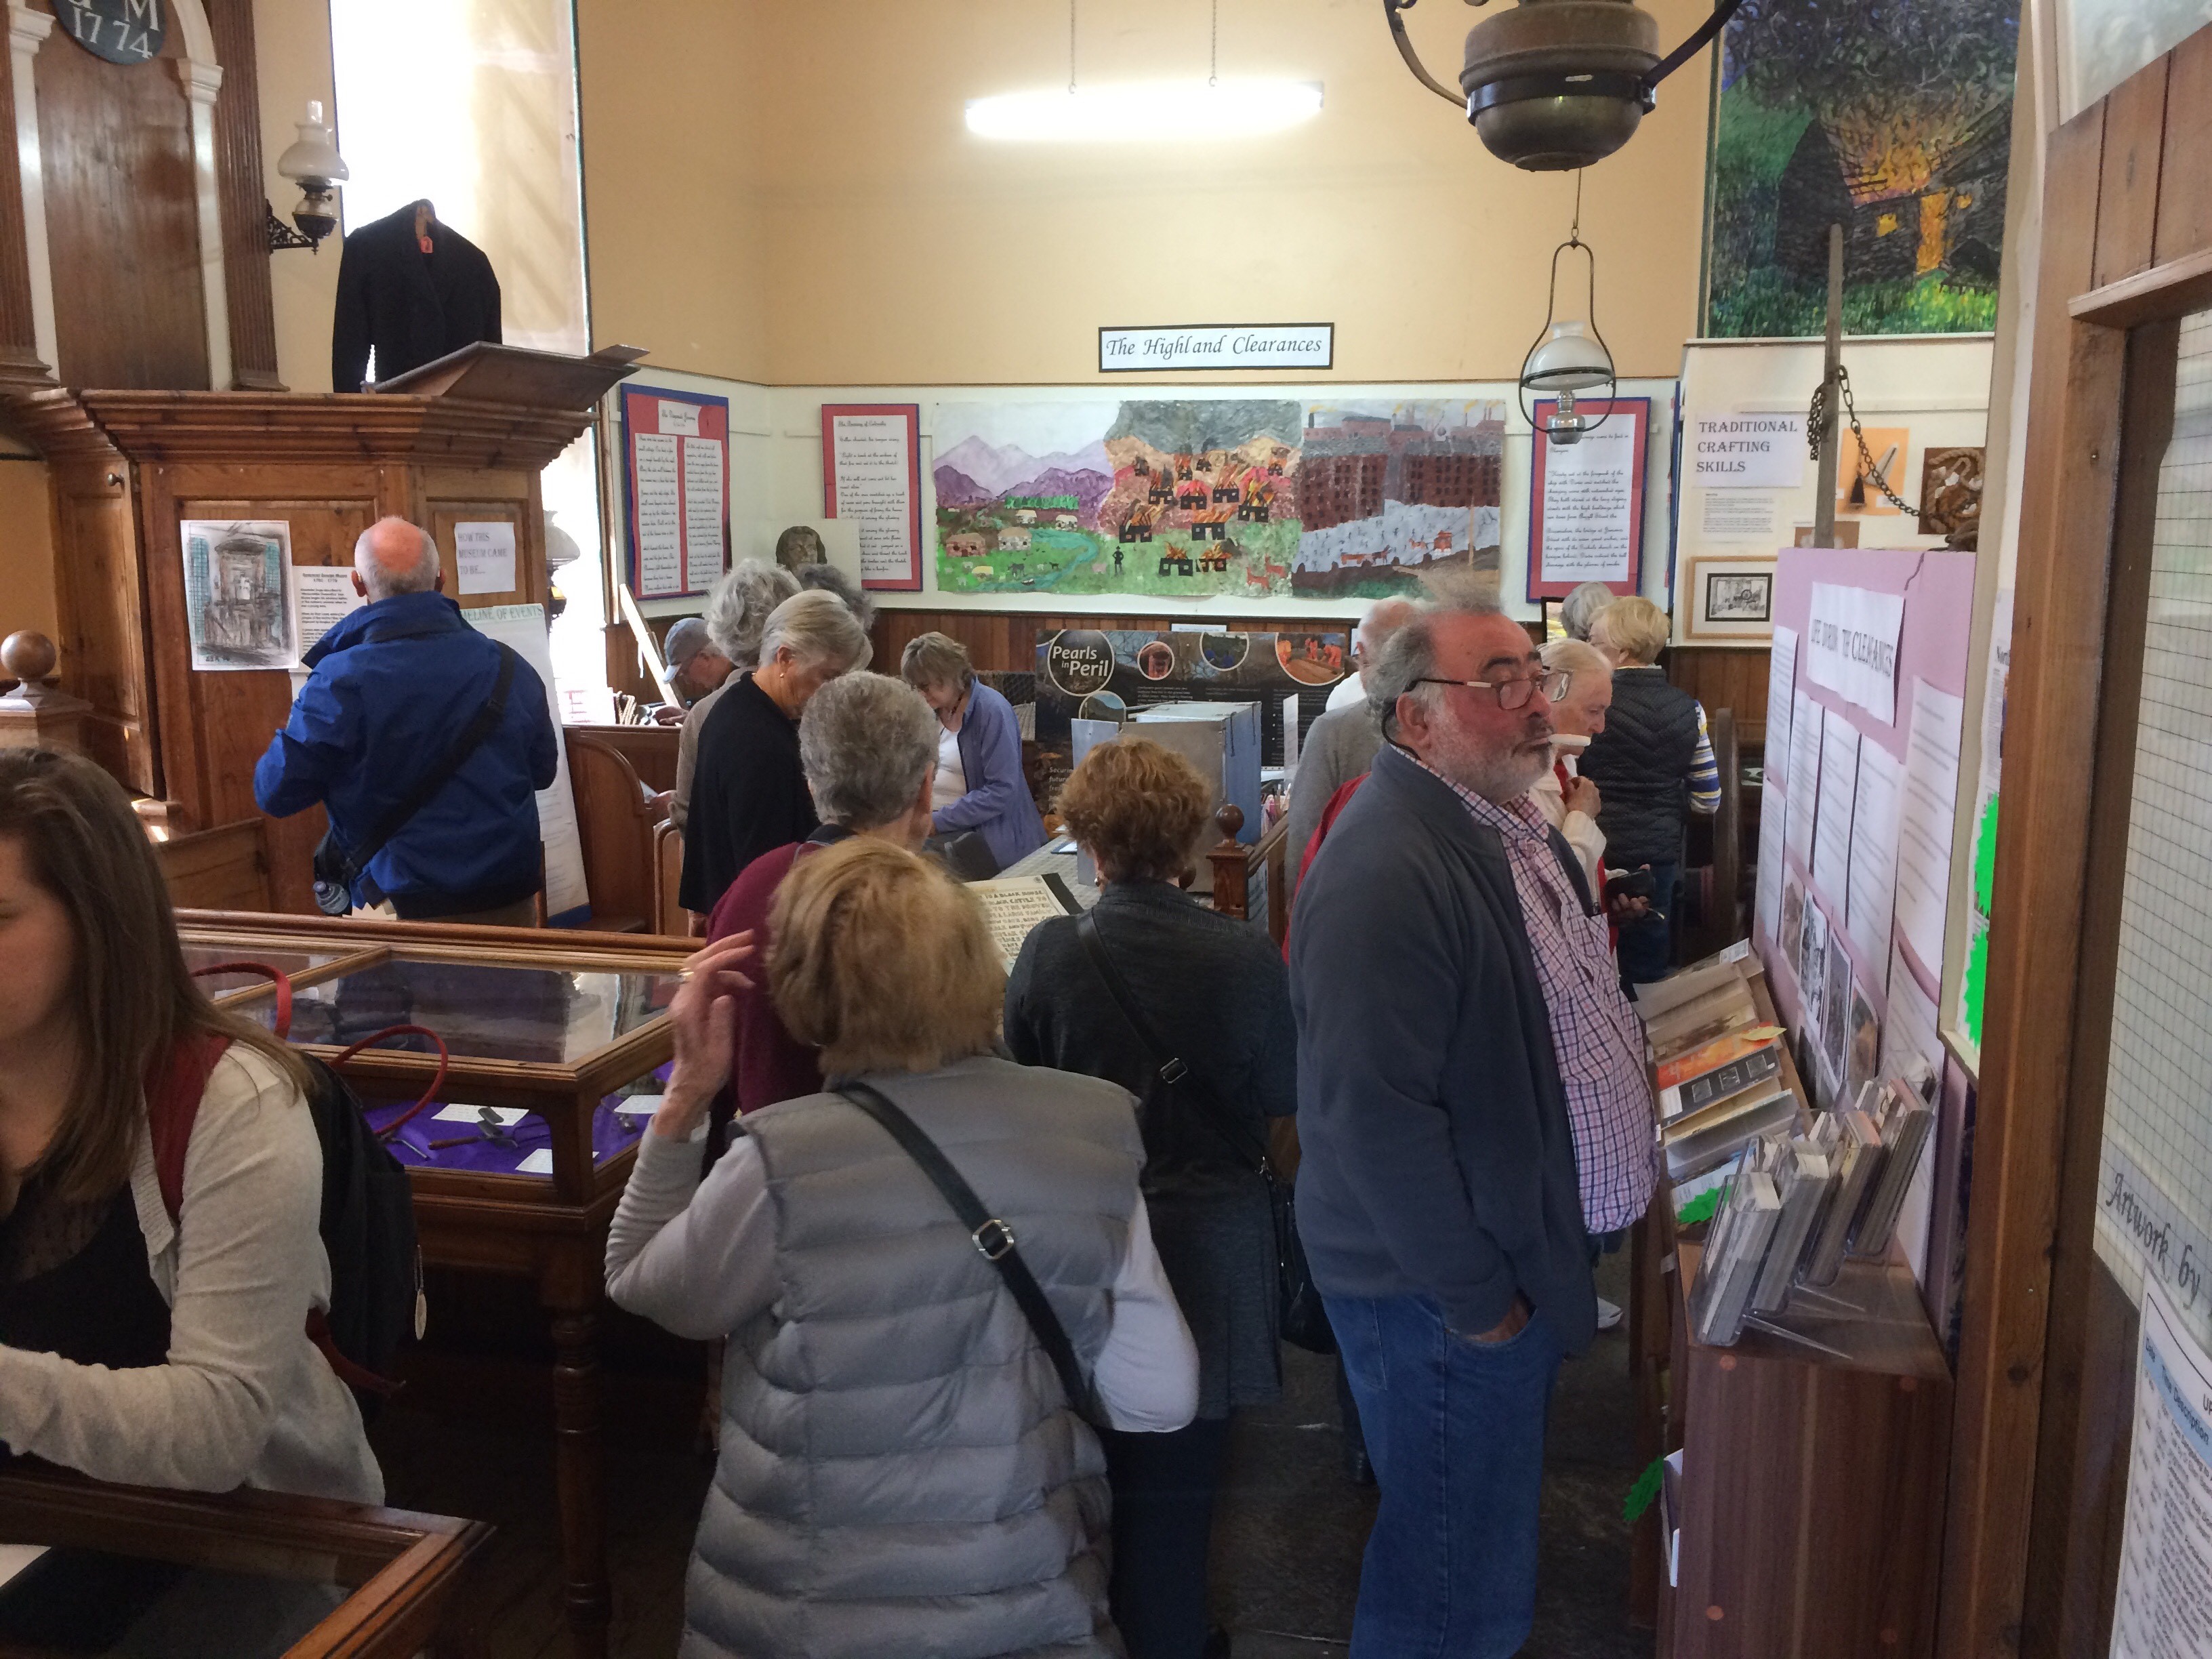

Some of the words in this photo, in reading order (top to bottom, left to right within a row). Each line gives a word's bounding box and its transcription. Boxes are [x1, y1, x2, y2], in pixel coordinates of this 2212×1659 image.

[1106, 337, 1134, 355] The
[1143, 335, 1227, 360] Highland
[1232, 334, 1322, 354] Clearances
[1699, 421, 1798, 432] TRADITIONAL
[1698, 441, 1771, 453] CRAFTING
[1696, 462, 1746, 472] SKILLS
[457, 533, 474, 541] HOW
[475, 532, 489, 541] THIS
[459, 549, 487, 558] MUSEUM
[487, 548, 508, 558] CAME
[459, 565, 468, 575] TO
[497, 608, 507, 620] OF
[510, 605, 543, 619] EVENTS
[1052, 645, 1098, 660] Pearls
[1061, 659, 1069, 668] in
[1069, 659, 1108, 677] Peril
[2106, 1172, 2171, 1274] Artwork
[2178, 1244, 2200, 1310] by
